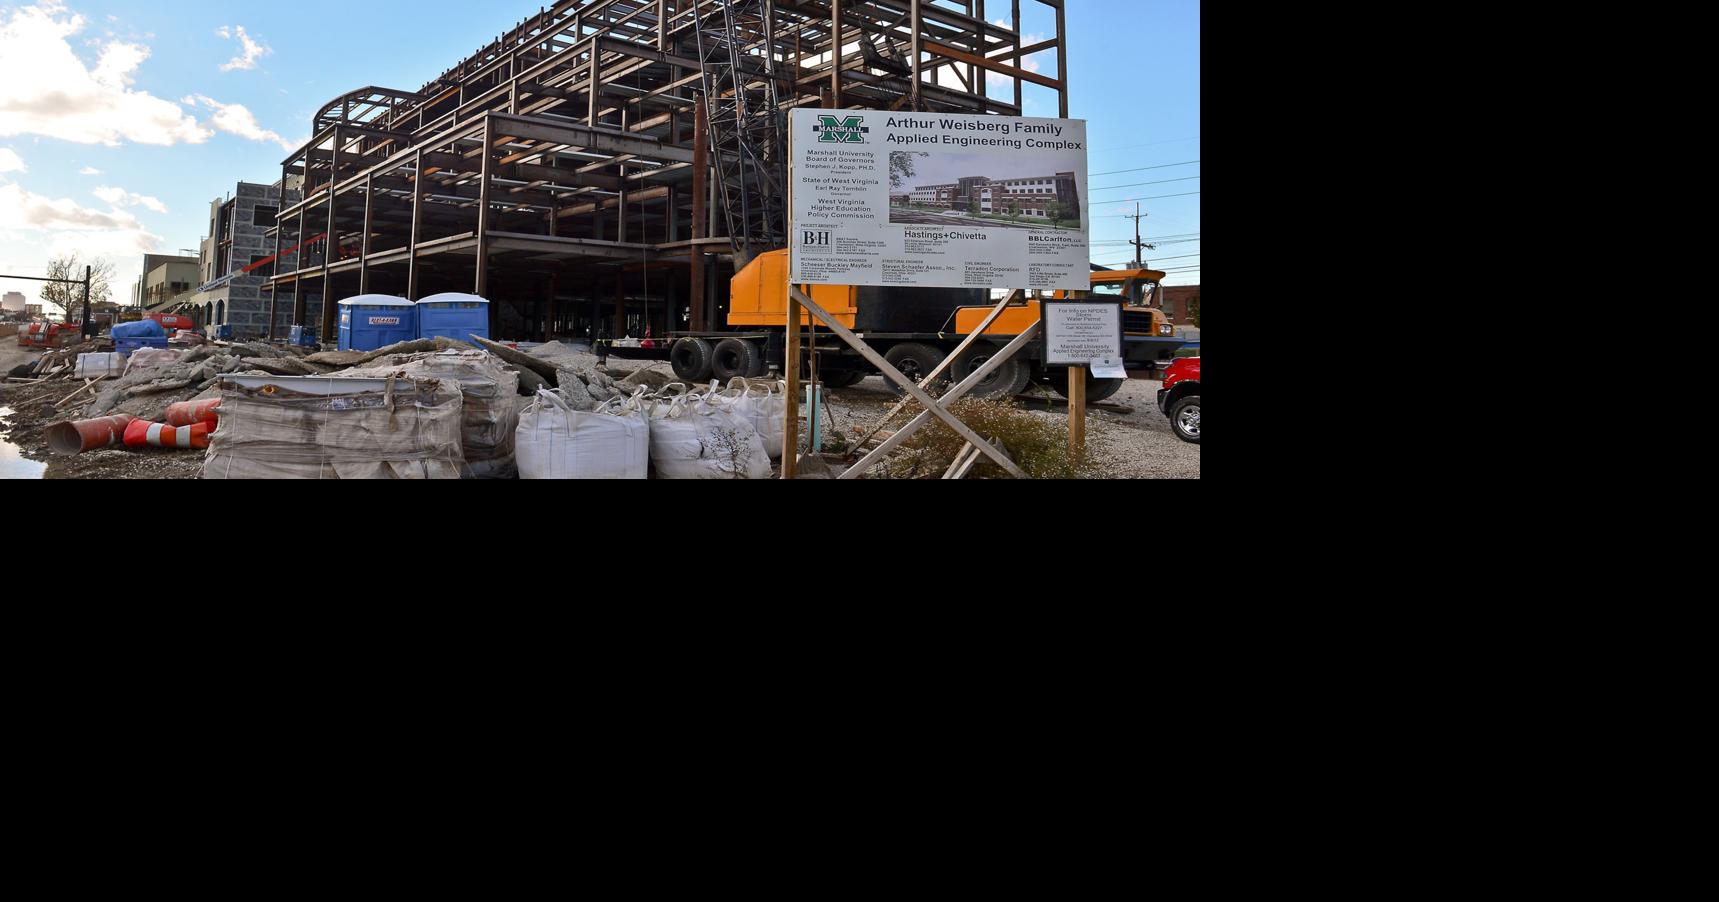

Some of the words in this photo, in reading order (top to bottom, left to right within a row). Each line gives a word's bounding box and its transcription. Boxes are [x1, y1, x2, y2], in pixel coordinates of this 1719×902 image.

[886, 116, 935, 128] Arthur
[939, 118, 1009, 134] Weisberg
[1015, 122, 1063, 136] Family
[886, 133, 938, 145] Applied
[942, 135, 1021, 149] Engineering
[1026, 138, 1082, 151] Complex
[904, 231, 986, 240] Hastings+Chivetta
